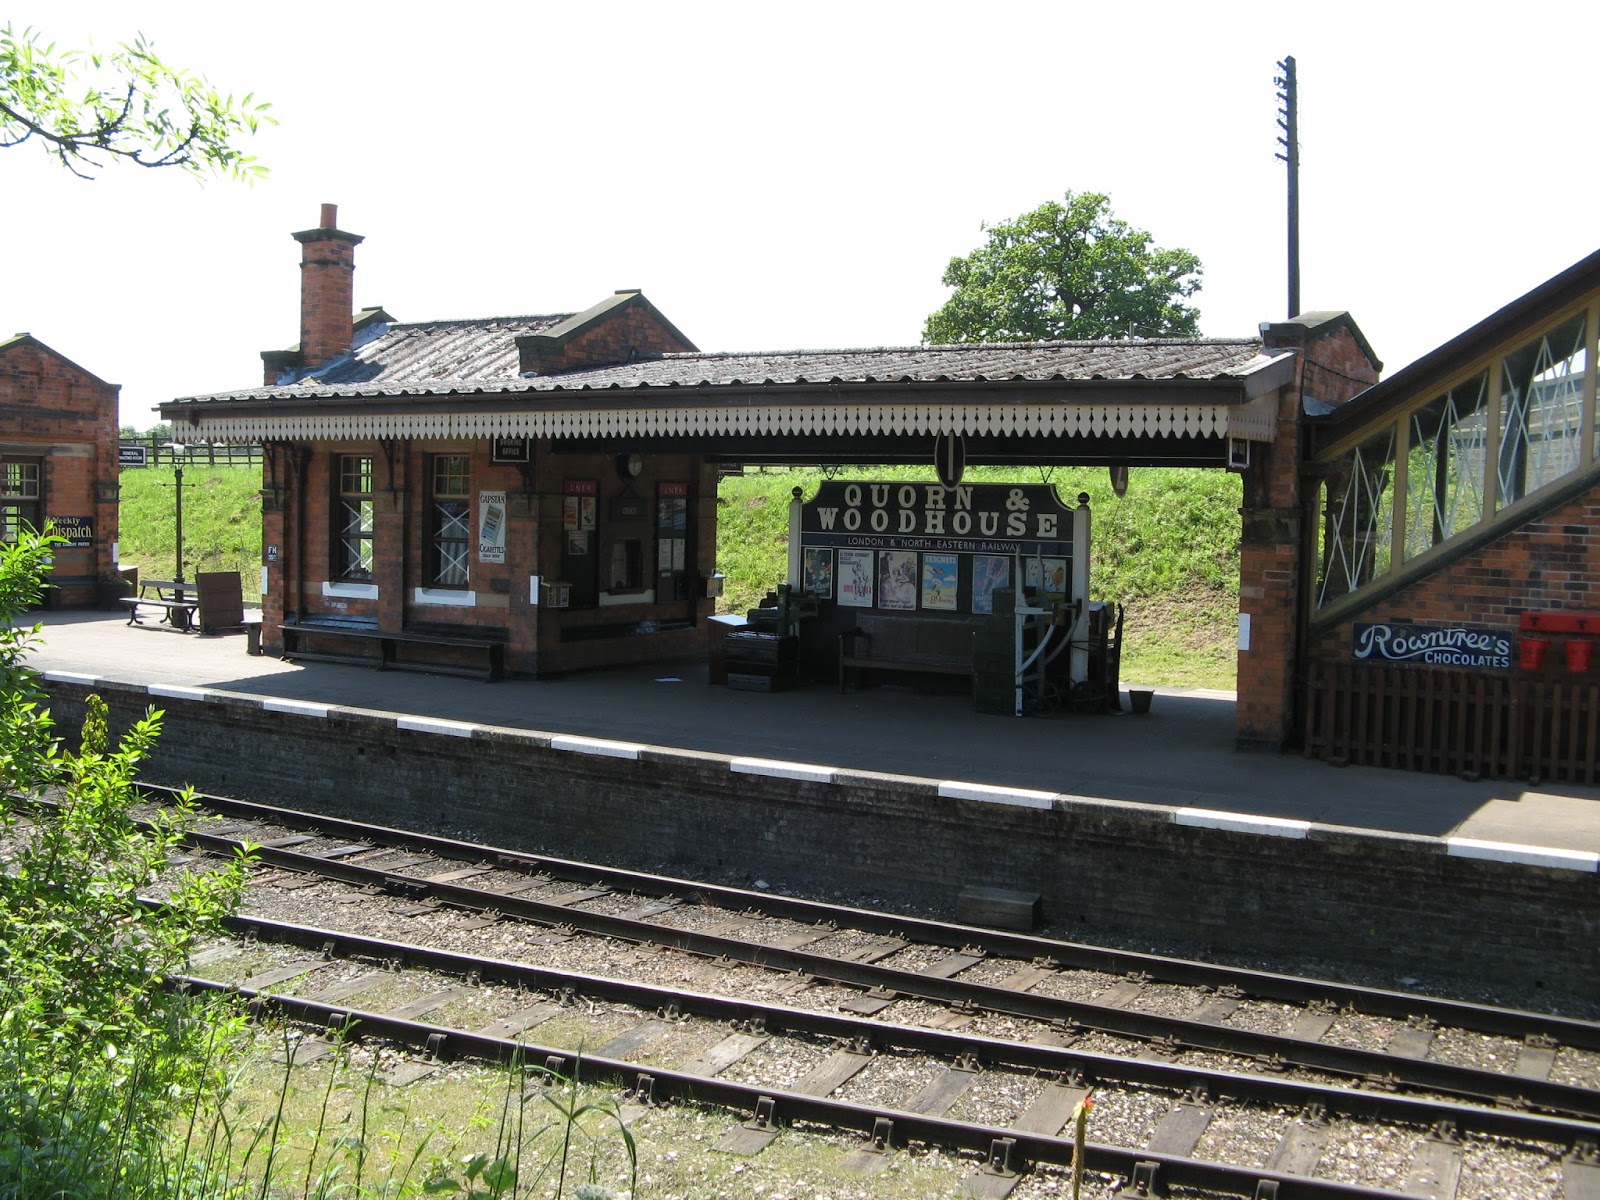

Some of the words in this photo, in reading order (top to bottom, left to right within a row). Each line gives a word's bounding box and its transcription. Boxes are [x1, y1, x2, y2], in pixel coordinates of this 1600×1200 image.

[502, 447, 520, 456] OFFICE
[569, 484, 592, 492] LNER
[844, 484, 974, 511] QUORN
[1005, 488, 1030, 511] &
[52, 517, 80, 526] Weekly
[817, 507, 1058, 538] WOODHOUSE
[52, 525, 93, 540] Dispatch
[847, 537, 885, 546] LONDON
[890, 538, 896, 547] &
[901, 539, 932, 548] NORTH
[937, 540, 976, 550] EASTERN
[981, 542, 1021, 552] RAILWAY
[925, 554, 957, 564] SKEGNESS
[1354, 625, 1510, 660] Rowntree's
[1425, 651, 1510, 668] CHOCOLATES
